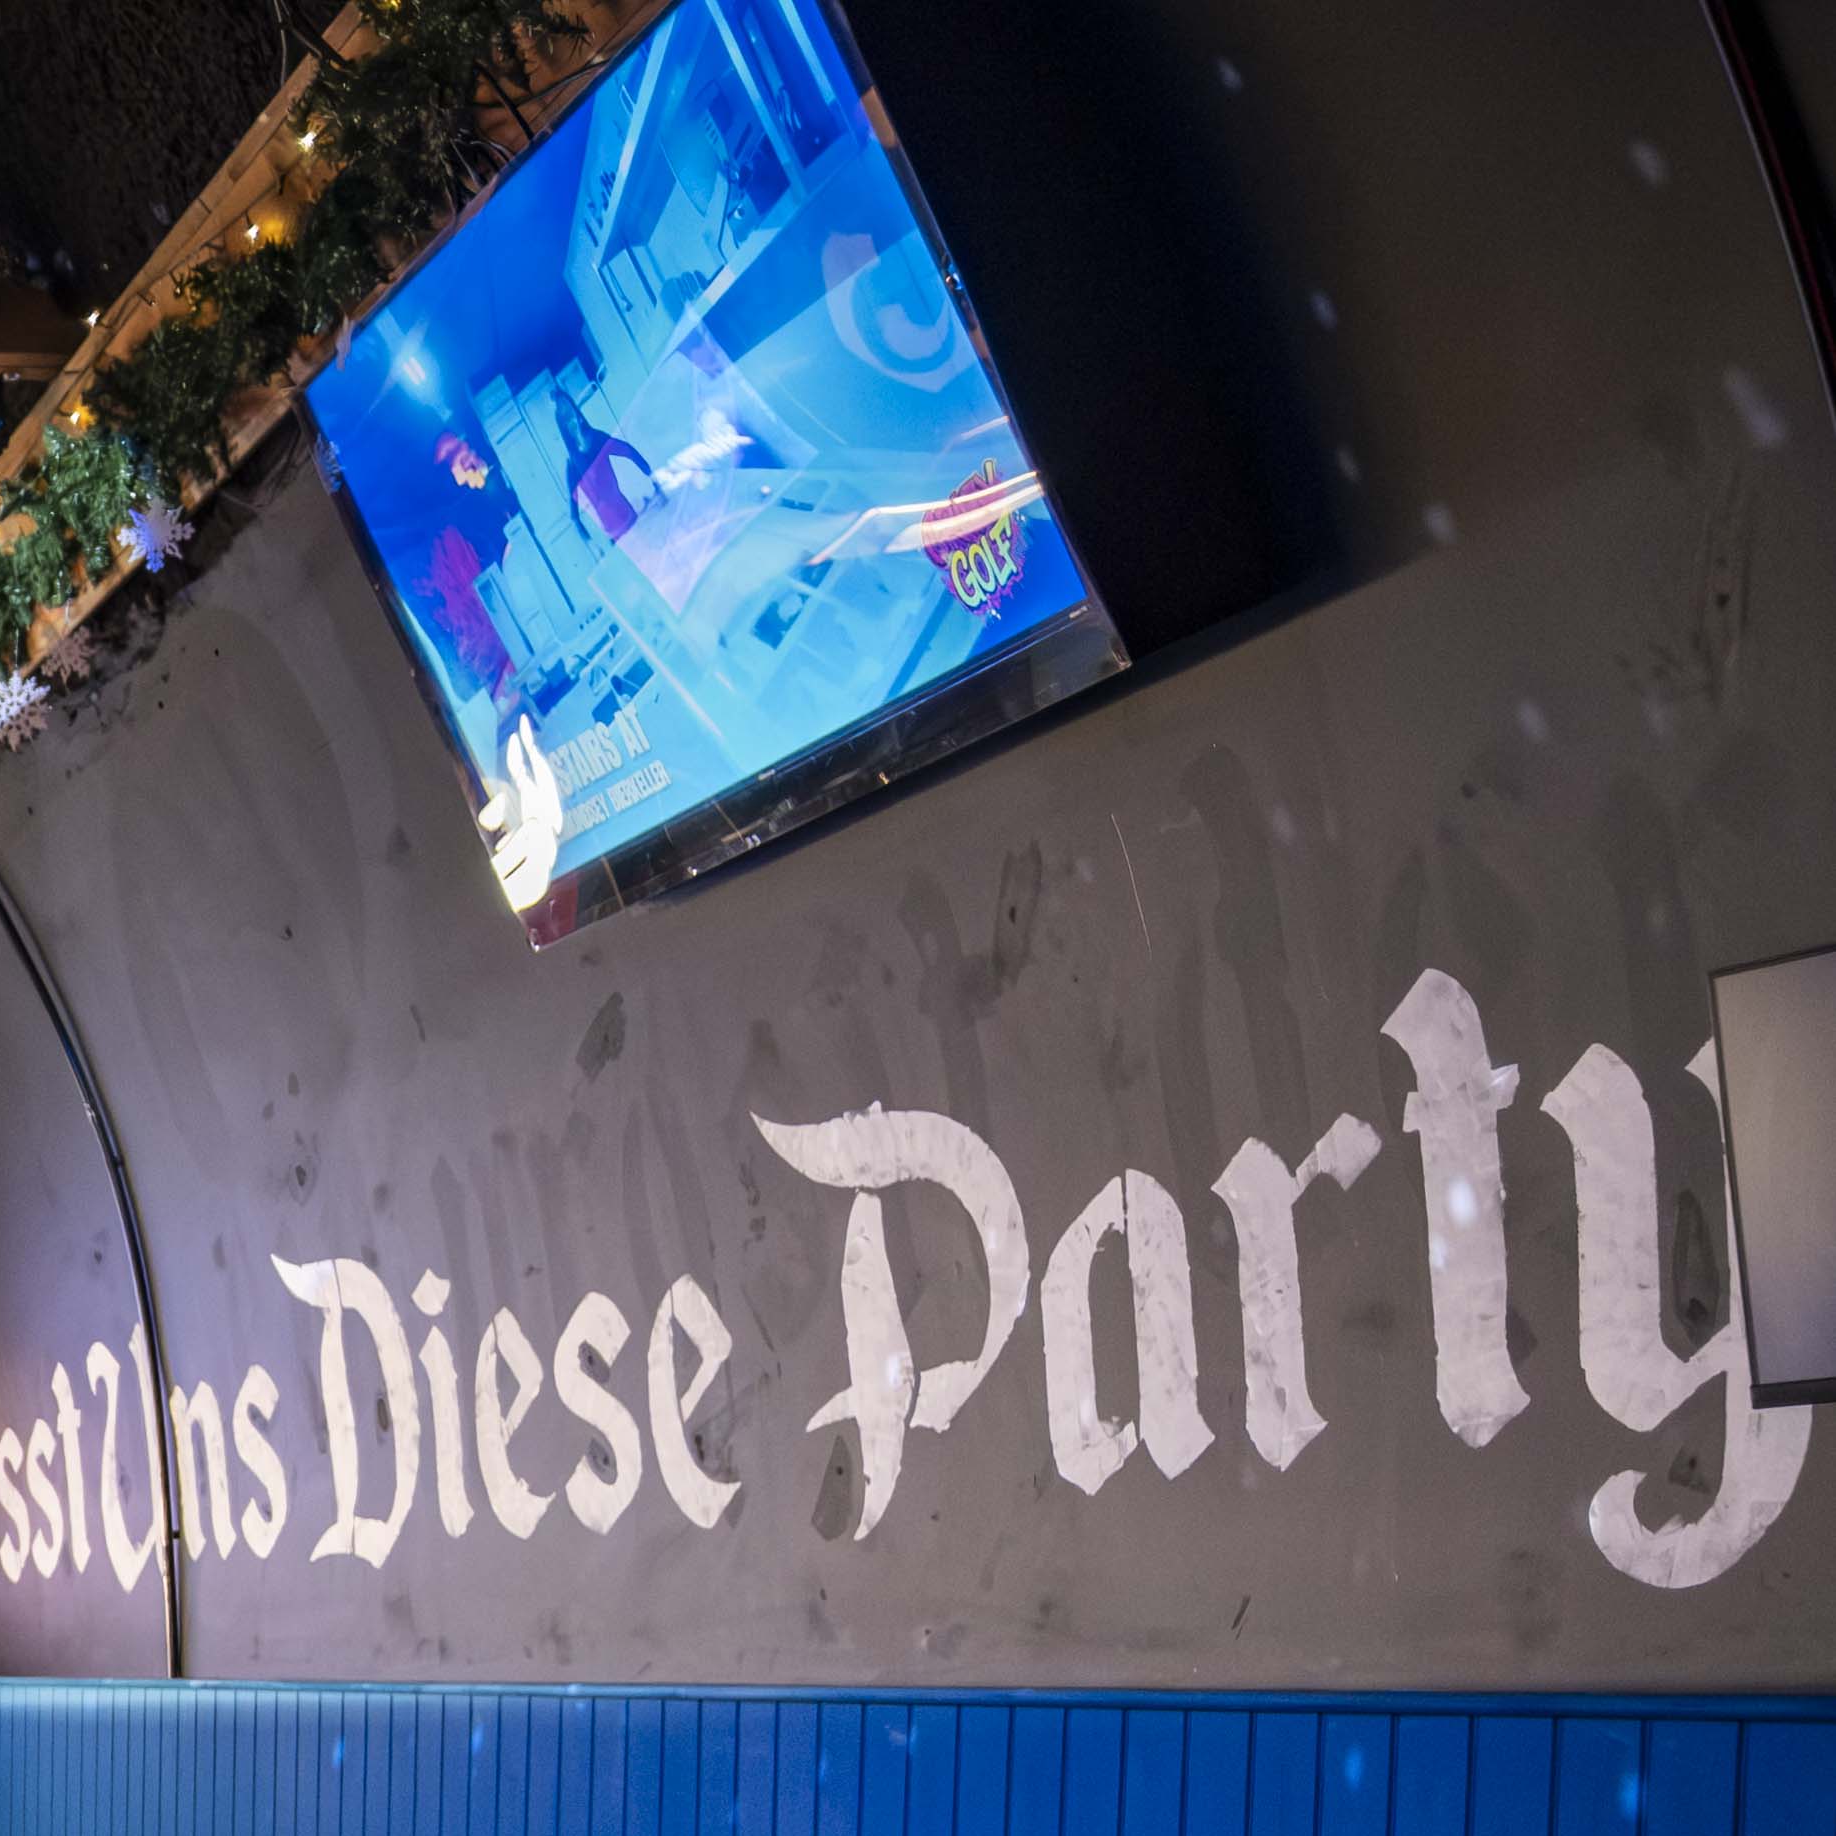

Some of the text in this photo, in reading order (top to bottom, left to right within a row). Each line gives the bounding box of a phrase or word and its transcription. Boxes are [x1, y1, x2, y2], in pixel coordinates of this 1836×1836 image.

[950, 509, 1018, 608] GOLF
[548, 700, 651, 798] STAIRS AT
[86, 1324, 287, 1593] Uns
[270, 1254, 741, 1568] Diese
[749, 968, 1813, 1589] Party
